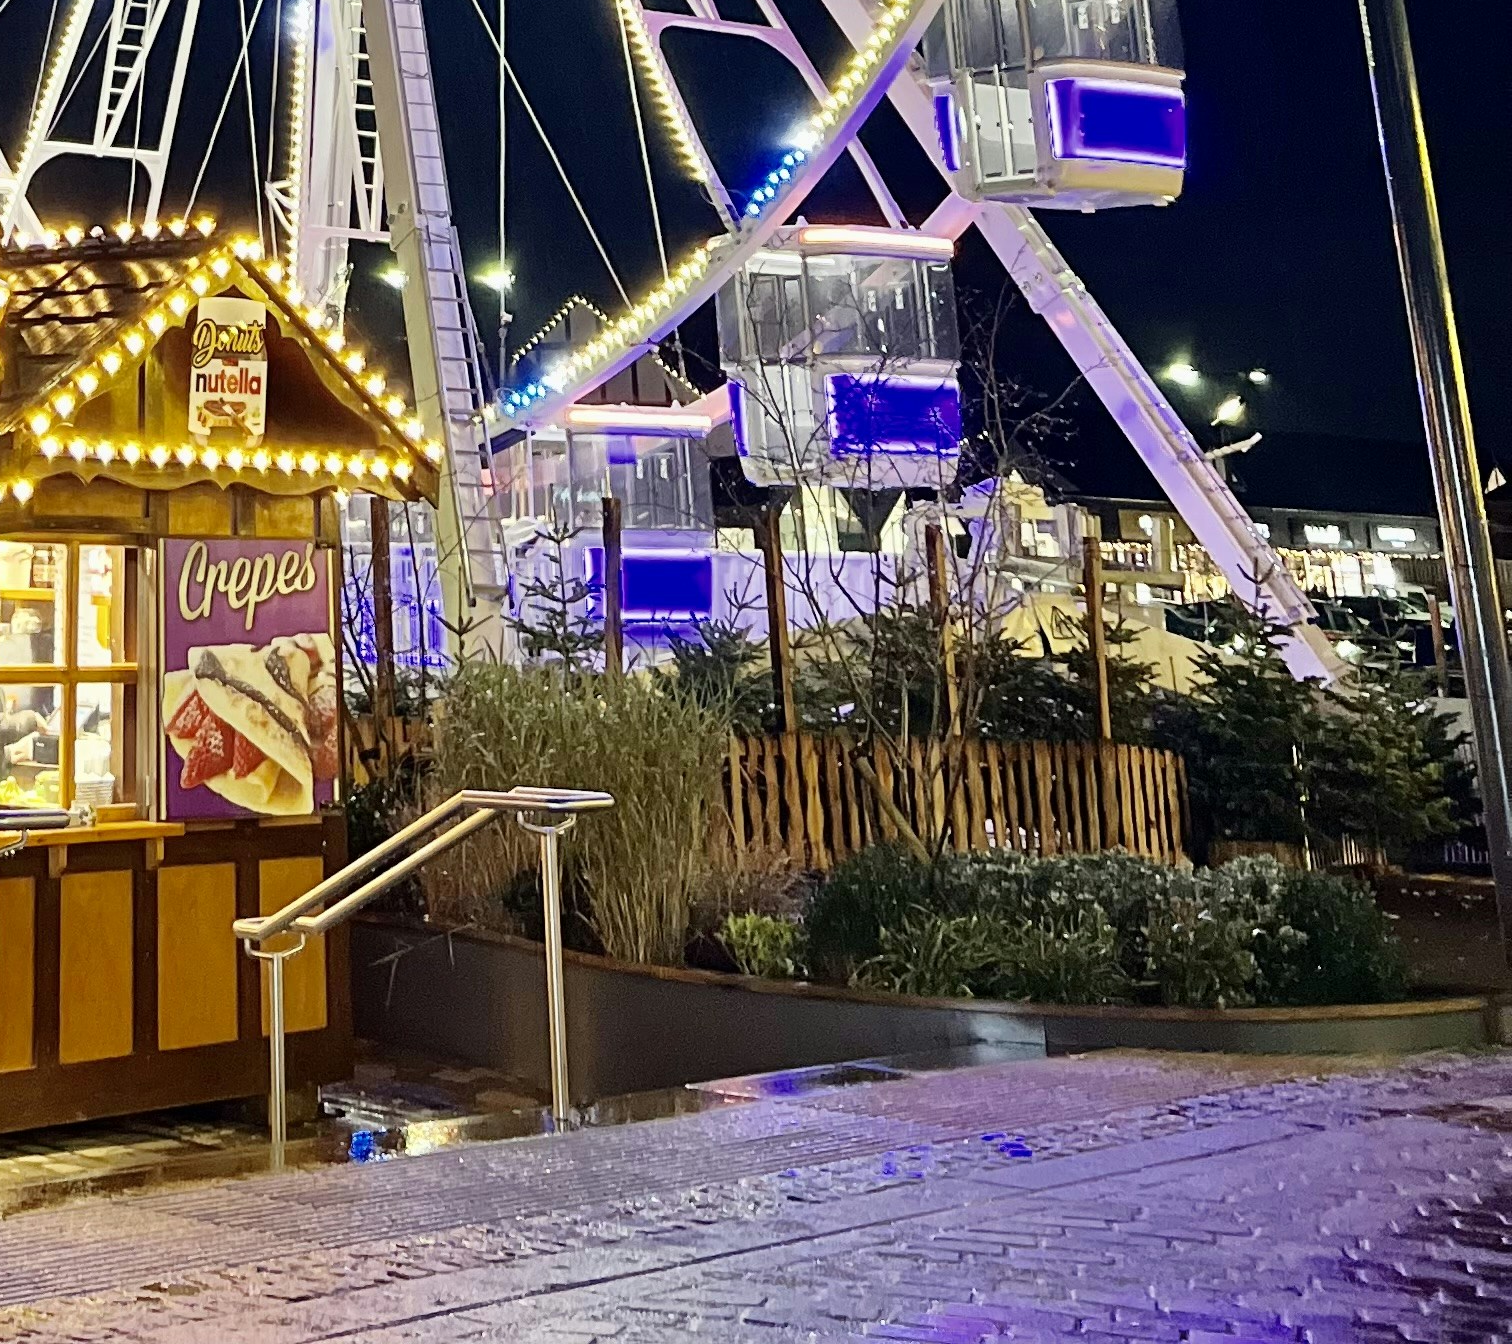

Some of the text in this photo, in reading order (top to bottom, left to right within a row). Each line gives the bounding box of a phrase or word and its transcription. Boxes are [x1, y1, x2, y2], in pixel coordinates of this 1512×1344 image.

[192, 318, 264, 368] Donuts
[196, 368, 261, 395] nutella
[179, 541, 316, 630] Crepes
